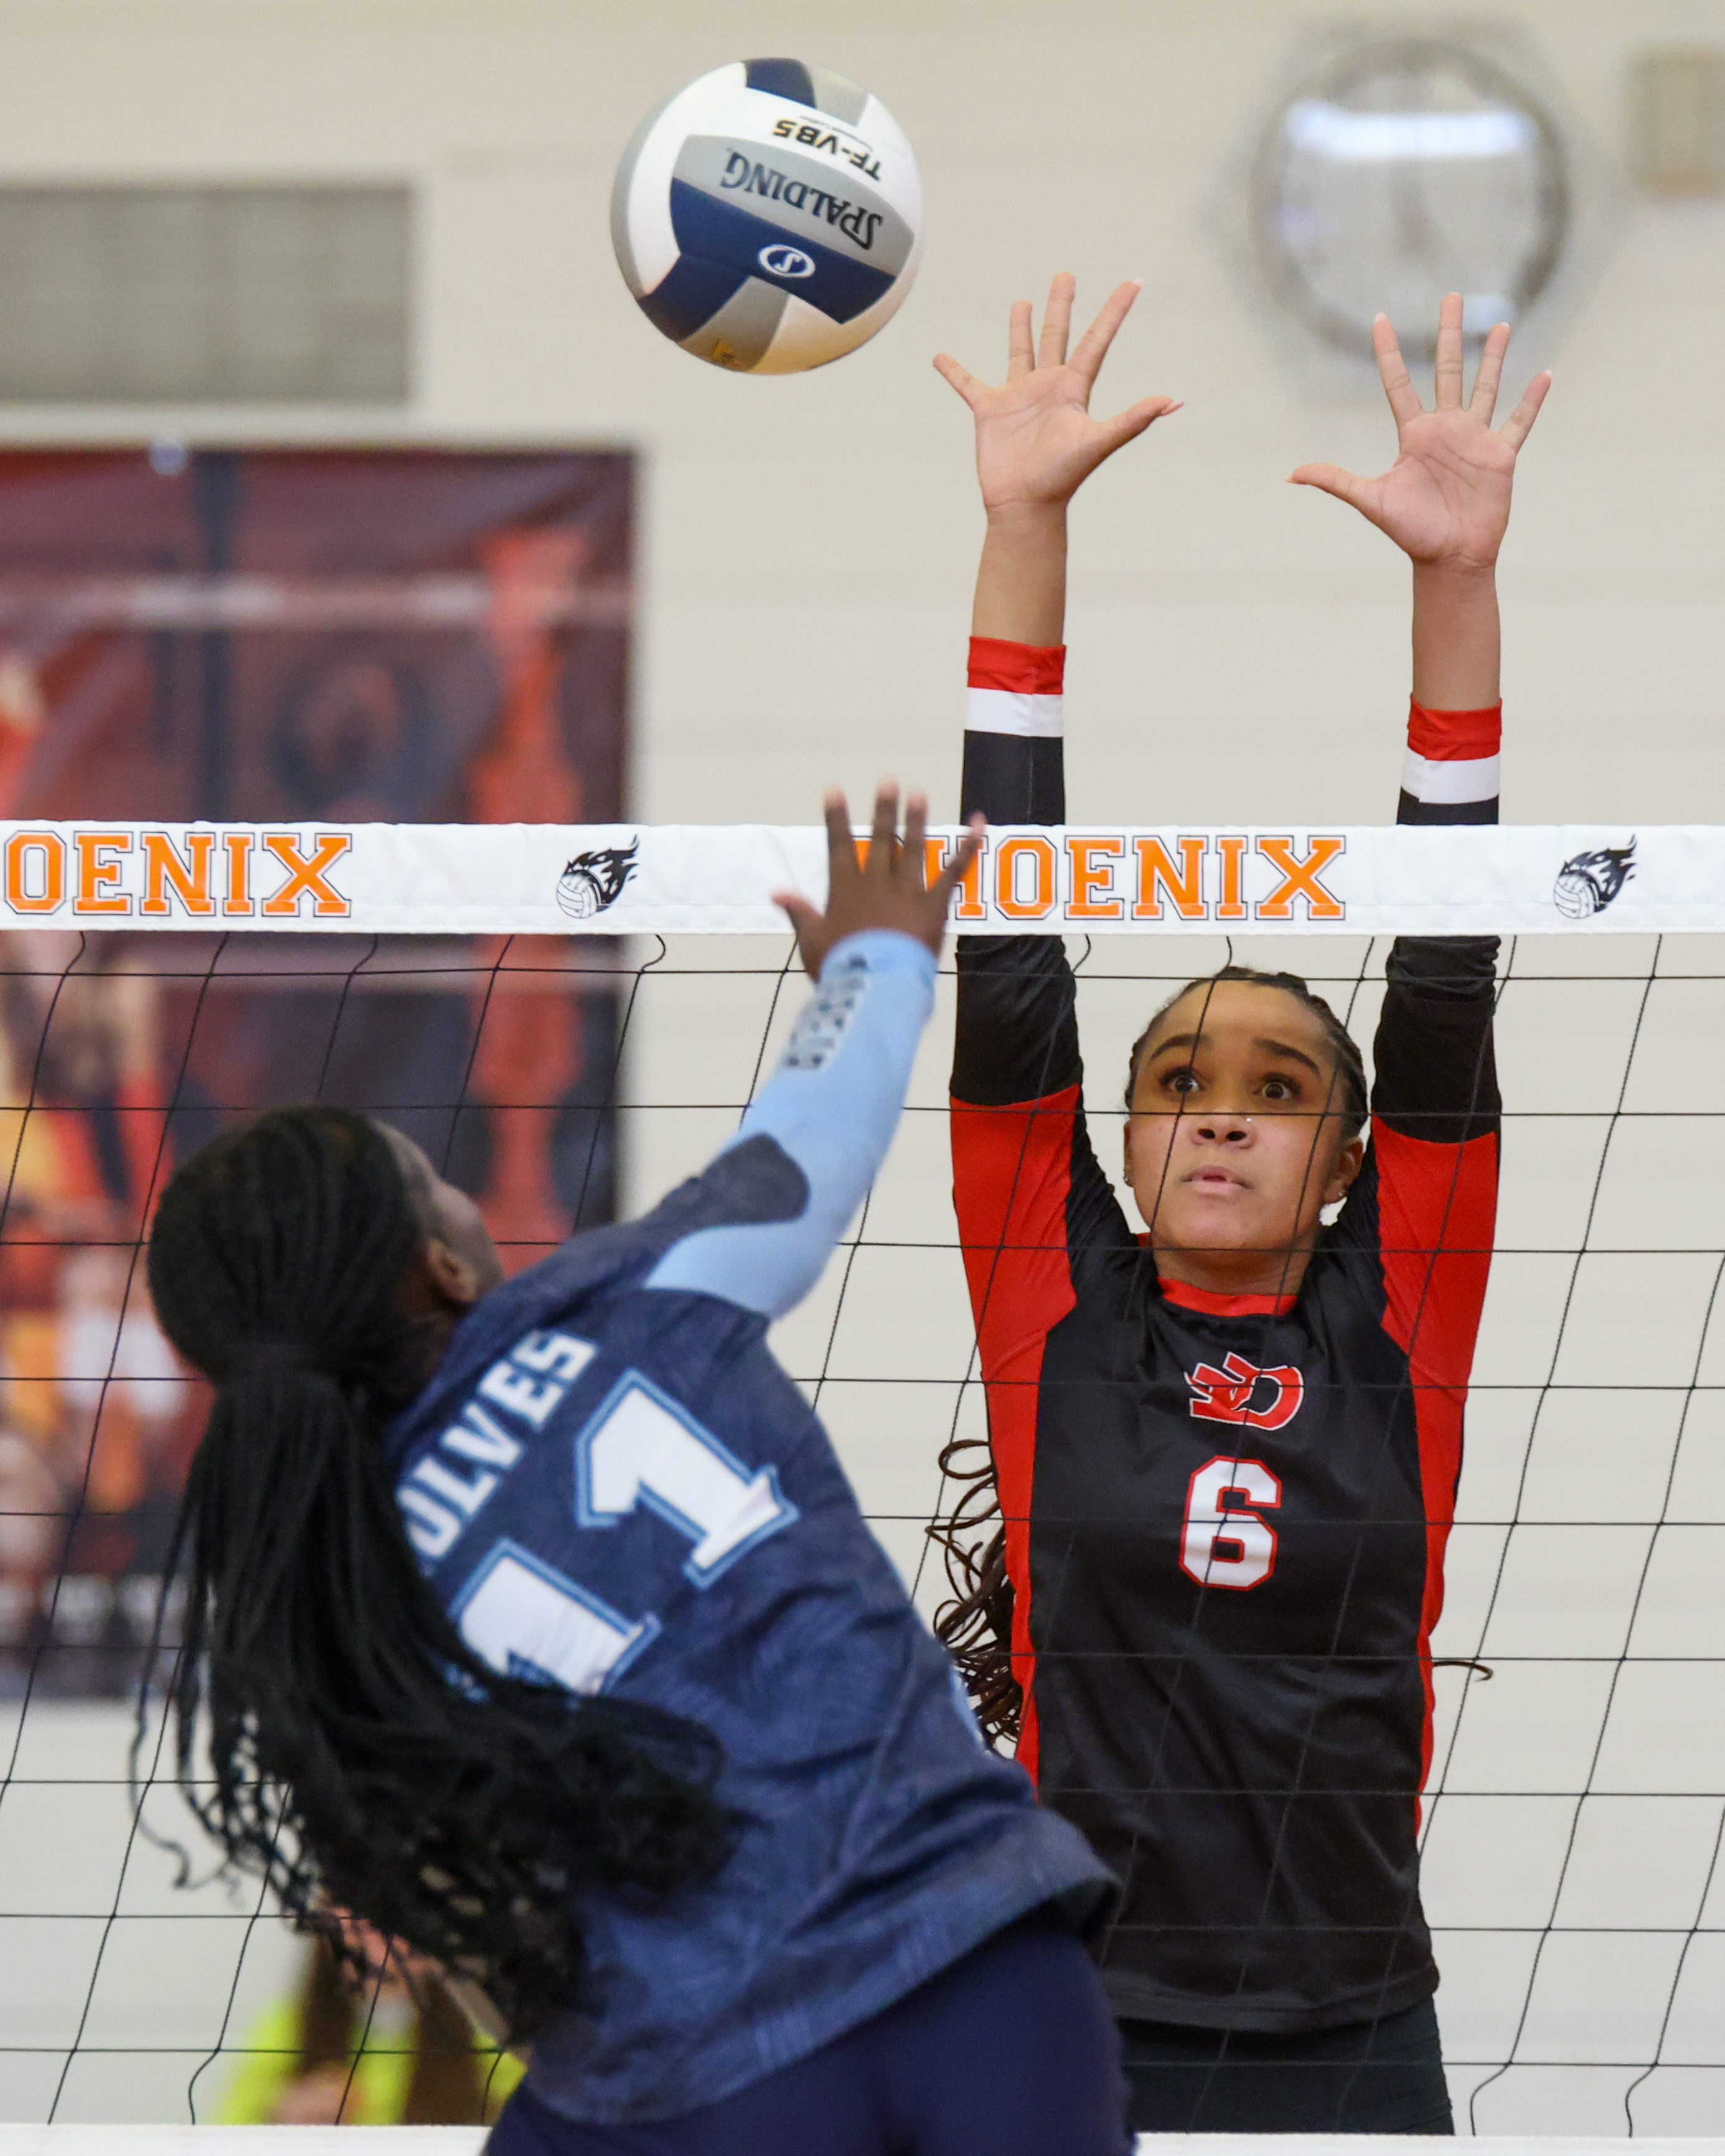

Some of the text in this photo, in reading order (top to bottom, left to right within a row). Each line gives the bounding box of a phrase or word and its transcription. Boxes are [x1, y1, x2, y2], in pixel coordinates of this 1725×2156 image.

[772, 117, 882, 181] TF-VB5
[720, 149, 883, 250] SPALDING
[4, 830, 352, 917] OENIX
[848, 835, 1346, 921] HOENIX
[393, 1328, 598, 1575] OLVES
[1178, 1455, 1283, 1591] 6
